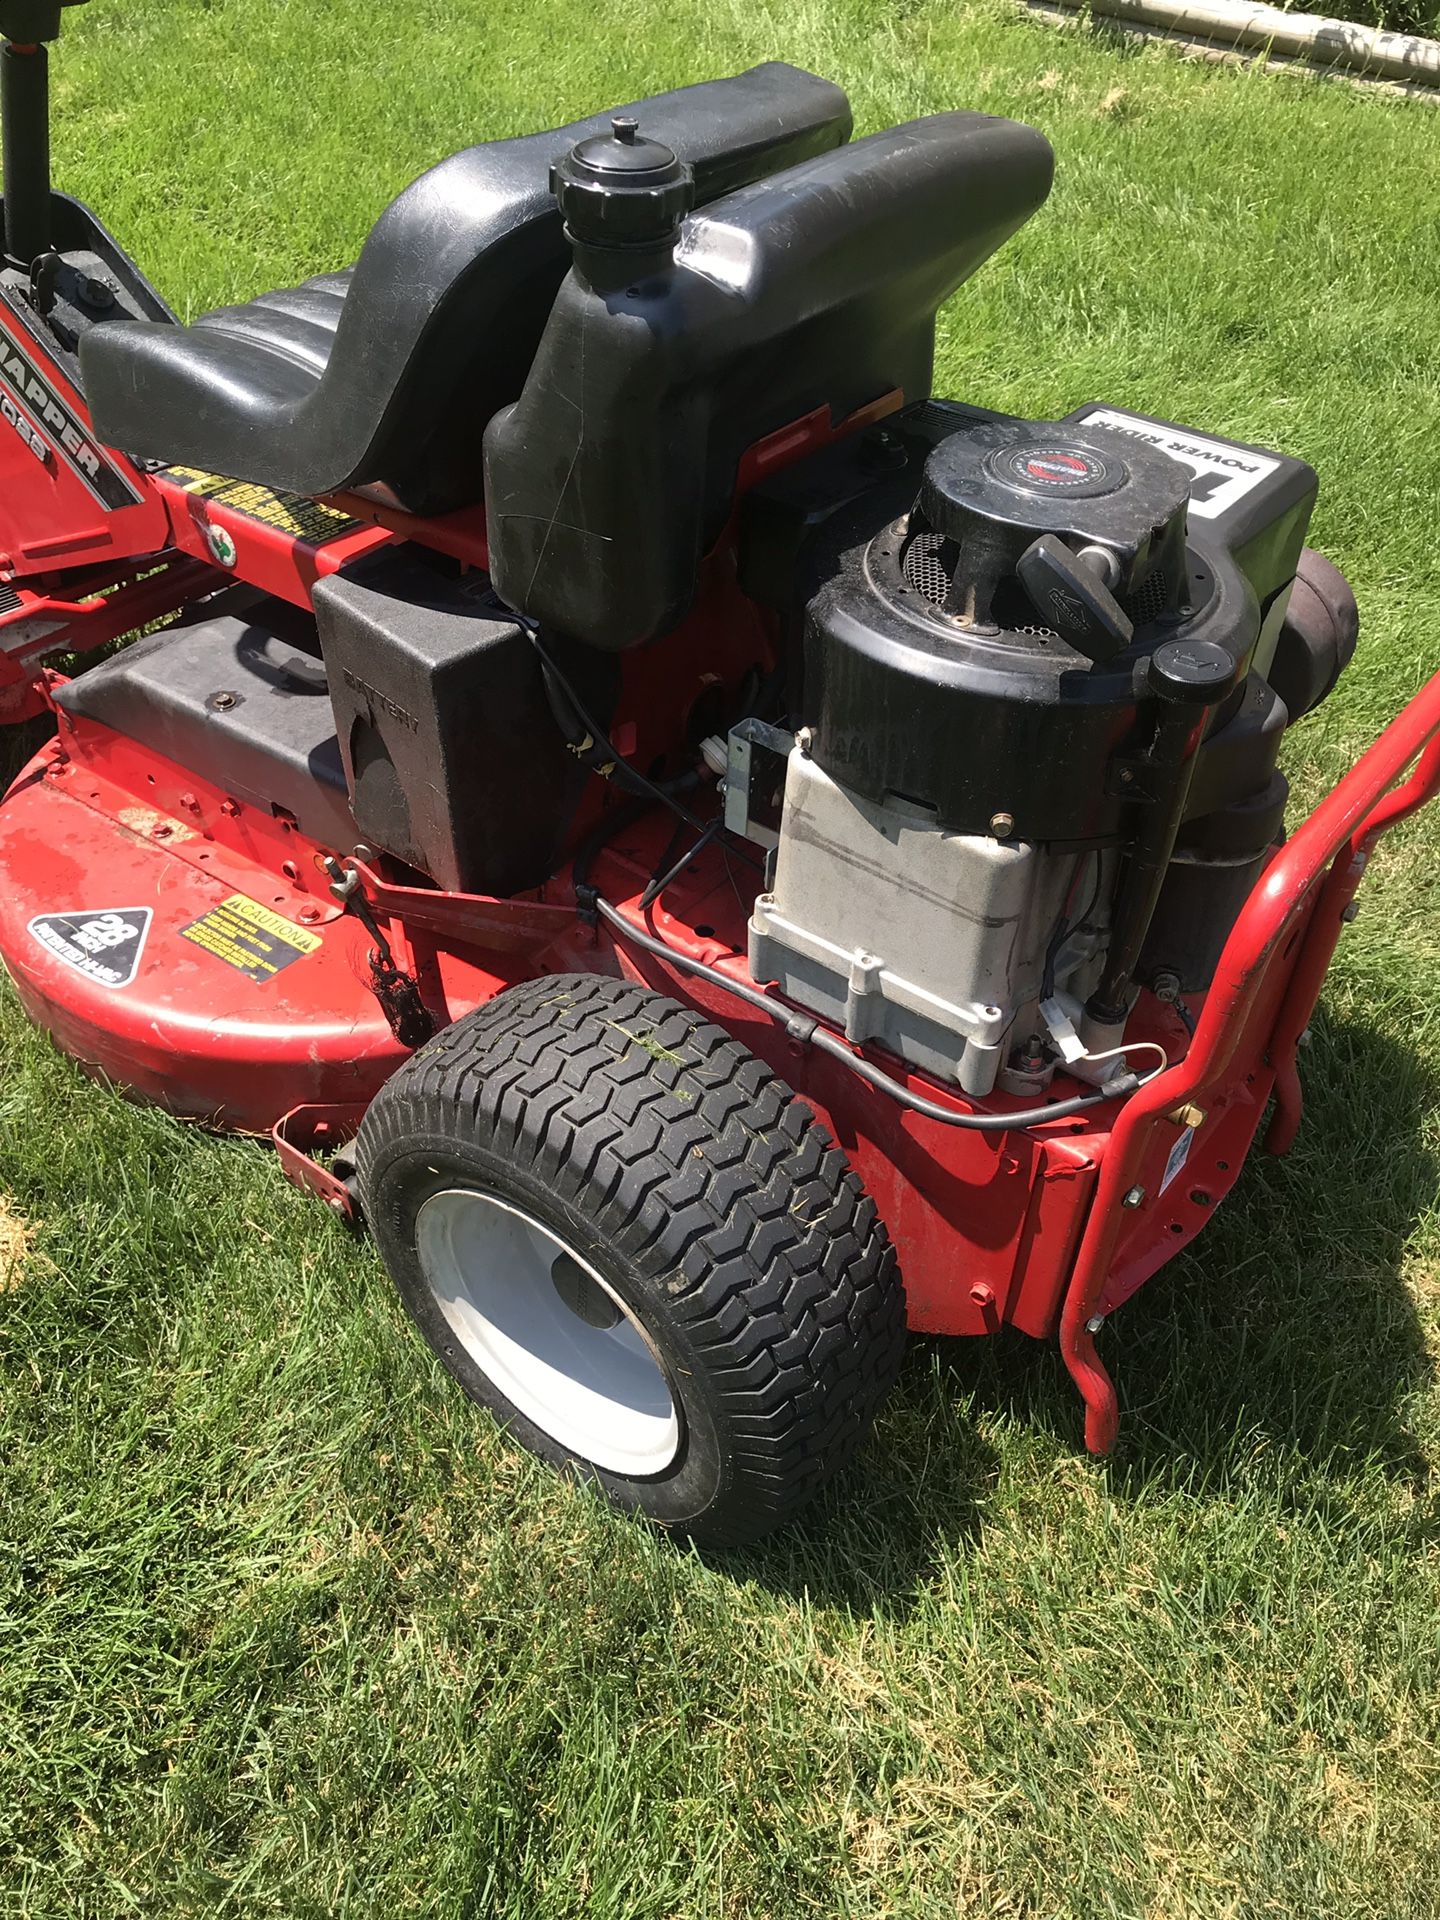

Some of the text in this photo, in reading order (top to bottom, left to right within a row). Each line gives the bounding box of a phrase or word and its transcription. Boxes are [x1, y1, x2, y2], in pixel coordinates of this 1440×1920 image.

[1167, 442, 1260, 473] POWER
[342, 667, 419, 735] BATTERY
[80, 914, 139, 946] 28
[240, 904, 302, 941] CAUTION
[33, 922, 87, 964] PATENTED
[70, 930, 107, 954] INCH
